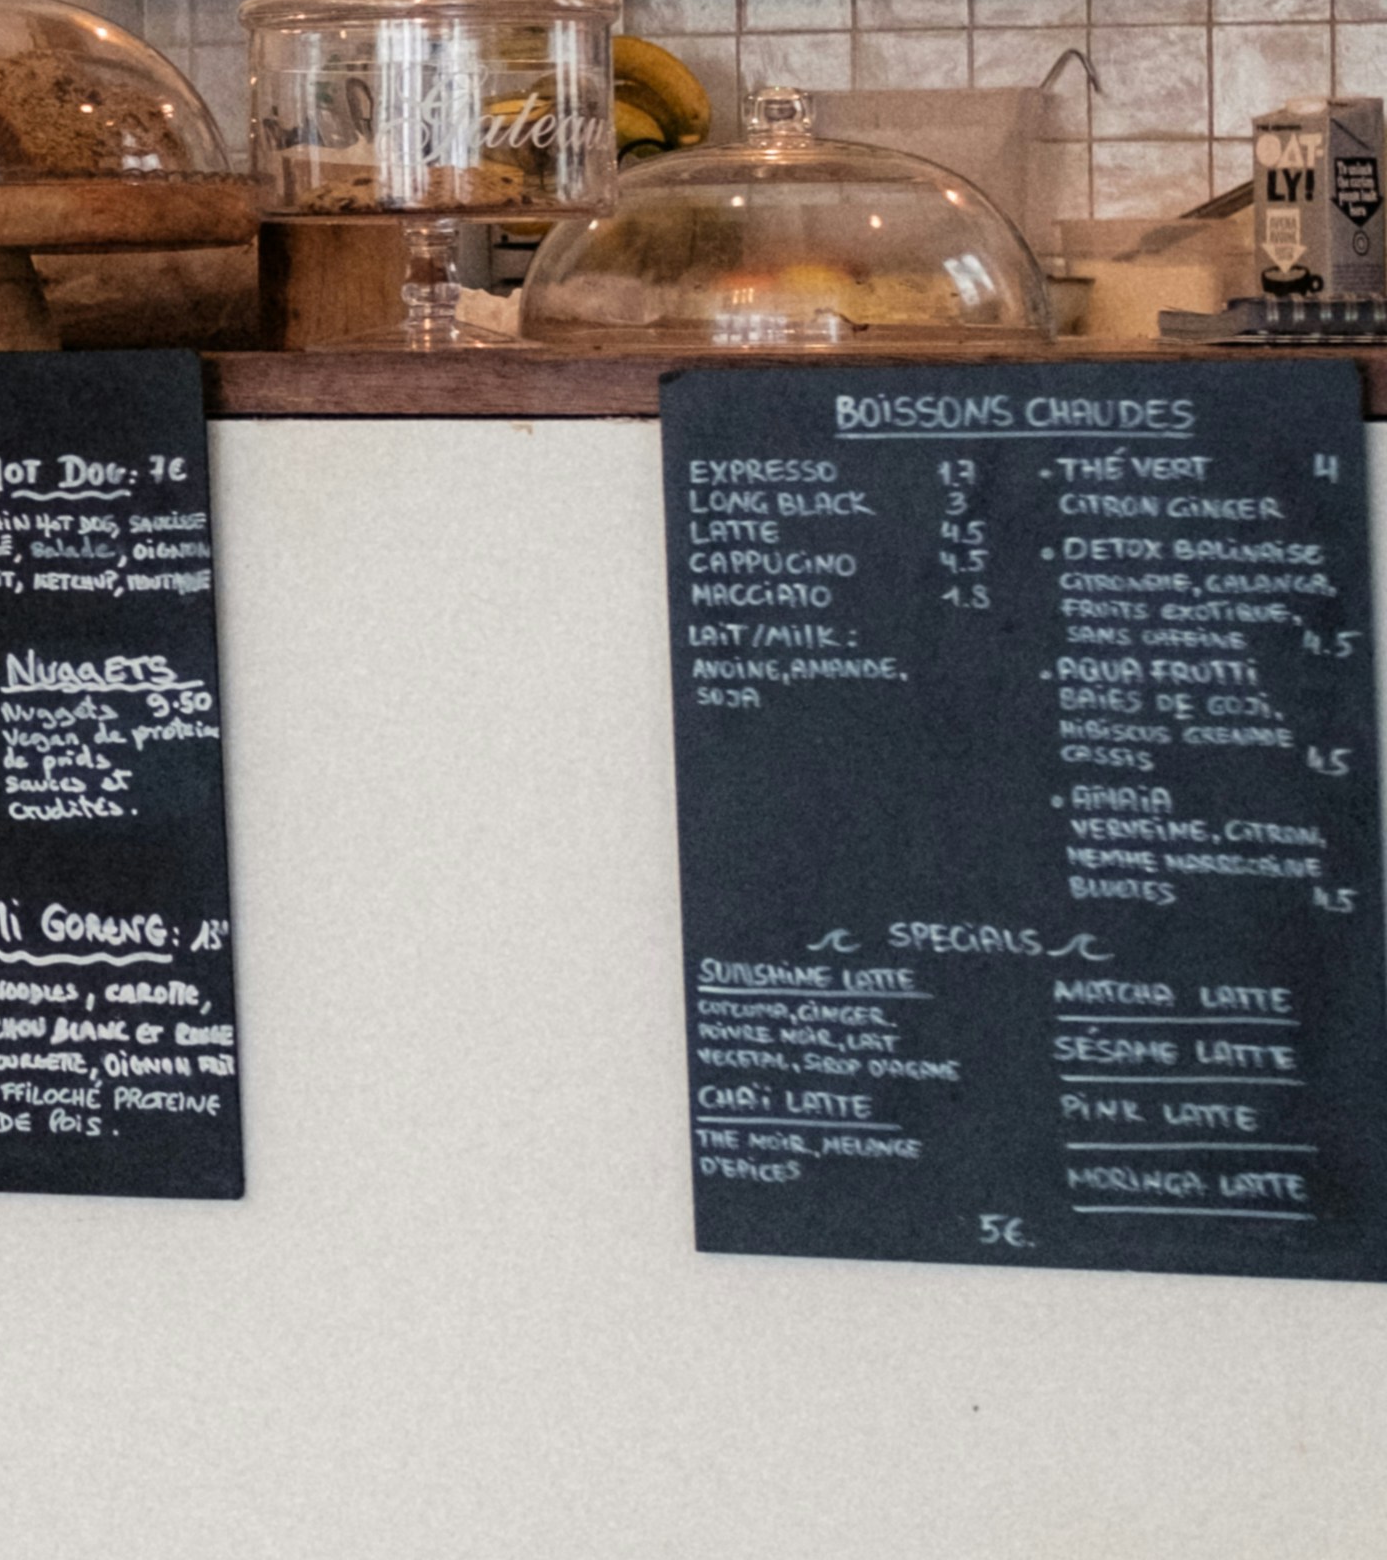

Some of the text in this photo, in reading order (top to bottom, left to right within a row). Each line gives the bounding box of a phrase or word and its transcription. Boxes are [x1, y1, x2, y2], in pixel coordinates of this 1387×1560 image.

[1027, 397, 1195, 430] CHAUDES
[148, 455, 187, 484] 7€
[689, 459, 838, 485] EXPRESSO
[1056, 447, 1339, 484] THÉ VERT 4
[689, 489, 968, 516] LONG BLACK 3
[689, 520, 779, 544] LATTE
[1063, 537, 1163, 562] DETOX
[1056, 656, 1143, 682] AQUA
[146, 691, 213, 717] 9.50
[696, 686, 760, 708] SOJA
[842, 968, 917, 991] LATTE
[1199, 985, 1292, 1013] LATTE
[1196, 1039, 1297, 1070] LATTE
[785, 1089, 873, 1118] LATTE
[1163, 1103, 1258, 1132] LATTE
